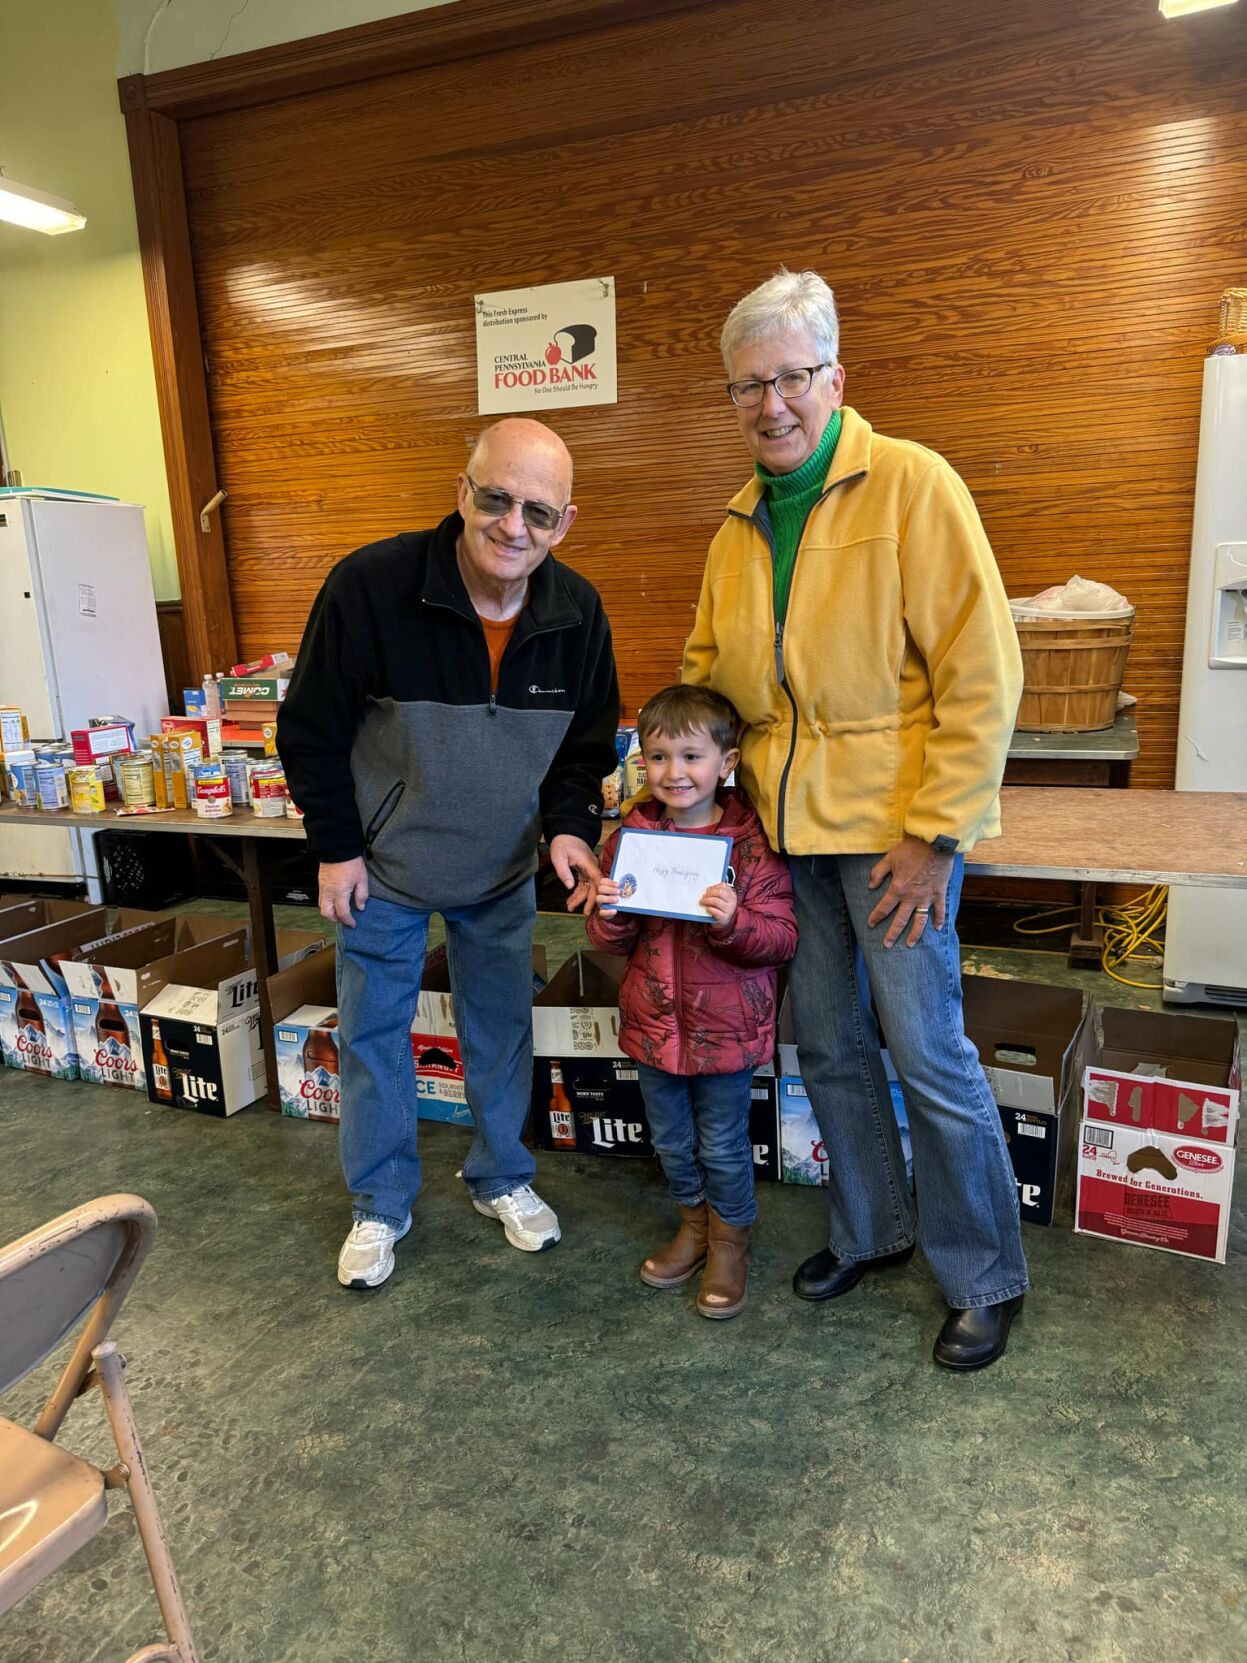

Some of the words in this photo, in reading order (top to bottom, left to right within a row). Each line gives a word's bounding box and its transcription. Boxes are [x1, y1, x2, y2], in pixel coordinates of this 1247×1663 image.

[482, 317, 514, 327] distribution
[514, 314, 541, 325] sponsored
[541, 312, 548, 321] by
[494, 308, 508, 317] Fresh
[508, 307, 528, 316] Express
[494, 352, 528, 364] CENTRAL
[494, 359, 547, 373] PENNSYLVANIA
[494, 368, 547, 389] FOOD
[549, 362, 597, 384] BANK
[542, 386, 552, 394] One
[553, 384, 571, 393] Should
[579, 382, 599, 391] Hungry
[229, 686, 271, 696] COMET
[15, 1034, 53, 1059] Coors
[22, 1053, 51, 1069] LIGHT
[94, 1048, 138, 1072] Coors
[612, 1061, 622, 1069] 24
[101, 1067, 135, 1083] LIGHT
[155, 1065, 168, 1076] Lite
[182, 1072, 219, 1104] Lite
[299, 1079, 340, 1104] Coor
[416, 1080, 436, 1096] CE
[307, 1098, 340, 1116] LIGH
[552, 1112, 570, 1124] Lite
[1014, 1112, 1027, 1121] 24
[591, 1116, 643, 1149] Lite
[1082, 1144, 1098, 1157] 24
[1175, 1150, 1219, 1165] GENESEE
[1096, 1169, 1129, 1184] Brewed
[1129, 1177, 1143, 1188] for
[1144, 1180, 1204, 1200] Generations.
[1124, 1192, 1170, 1209] GENESEE
